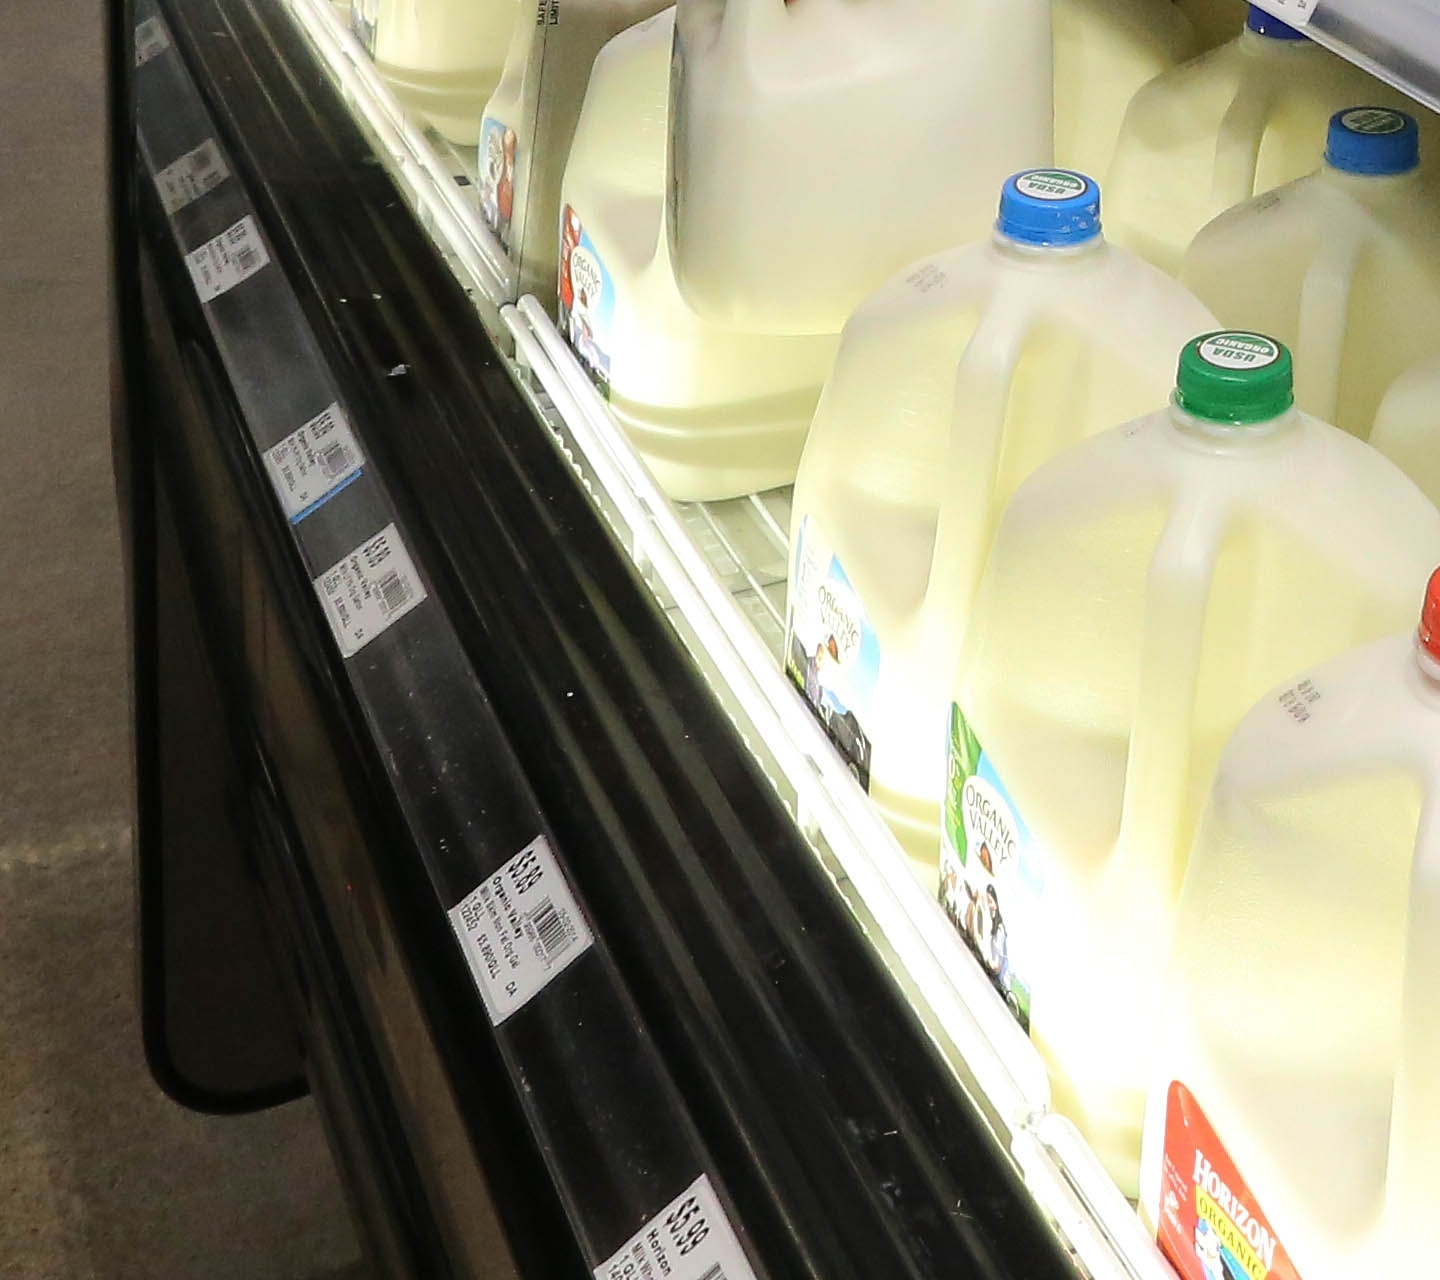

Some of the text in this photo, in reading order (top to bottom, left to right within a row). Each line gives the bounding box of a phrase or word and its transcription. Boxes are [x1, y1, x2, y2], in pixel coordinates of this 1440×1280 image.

[1212, 347, 1256, 362] USDA
[966, 784, 1016, 858] ORGANIC
[969, 809, 1007, 864] VALLEY
[508, 849, 543, 896] $5.89
[665, 1195, 712, 1257] $5.99
[1192, 1149, 1277, 1272] HORIZON
[1199, 1197, 1262, 1278] ORGANIC
[644, 1229, 673, 1277] Horizon
